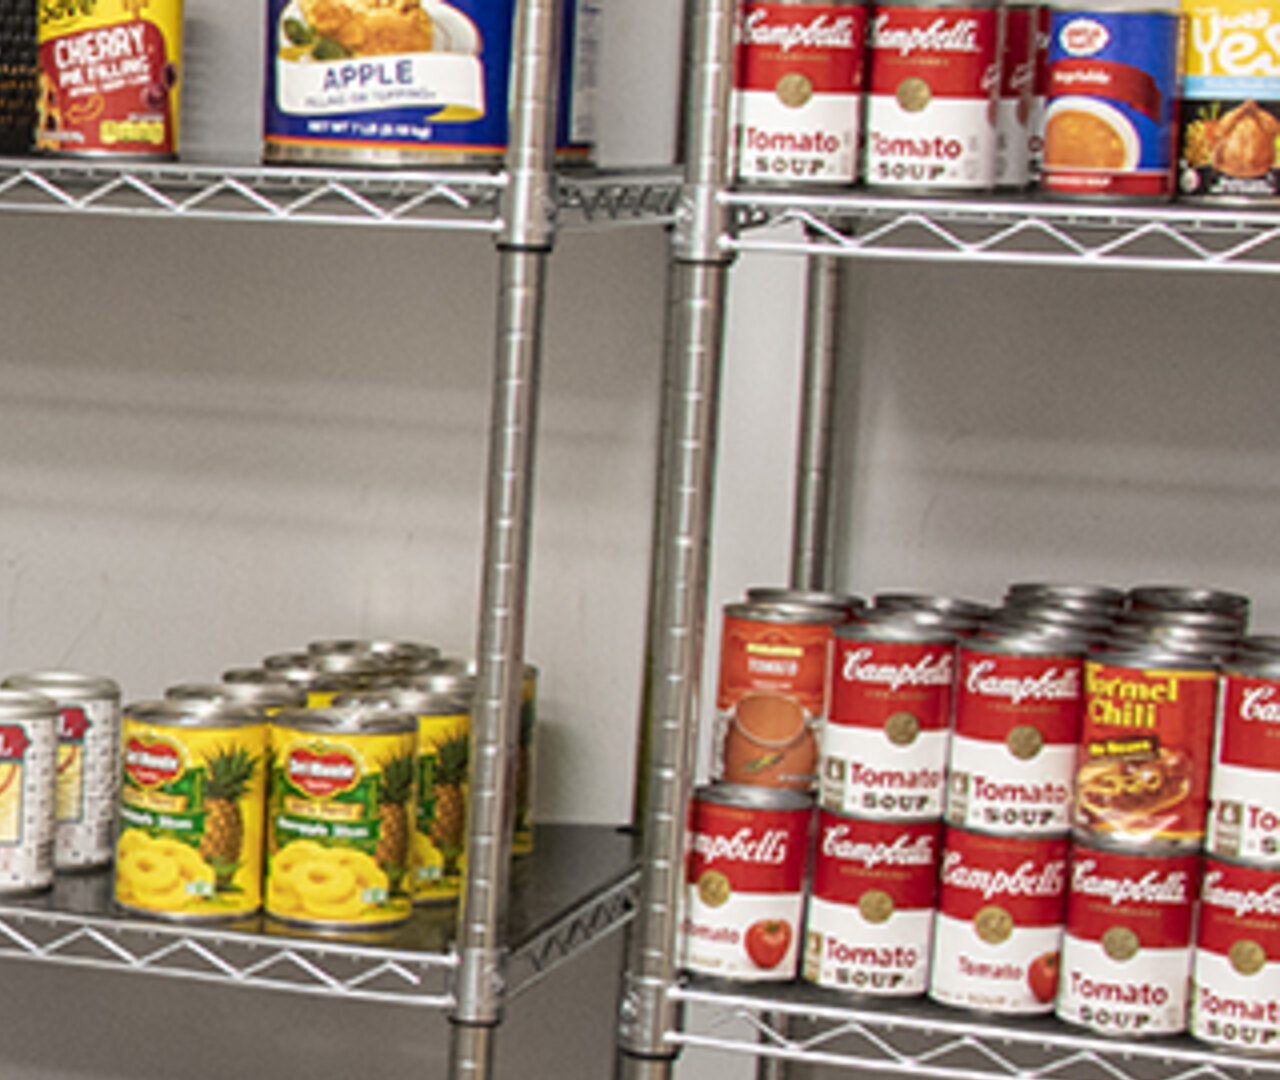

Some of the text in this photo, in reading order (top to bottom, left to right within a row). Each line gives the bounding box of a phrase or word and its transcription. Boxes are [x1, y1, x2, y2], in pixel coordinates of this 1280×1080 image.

[54, 25, 146, 70] CHERRY
[323, 60, 413, 91] APPLE
[747, 128, 839, 153] Tomato
[871, 131, 962, 159] Tomato
[754, 156, 825, 177] SOUP
[879, 163, 945, 180] SOUP
[1089, 700, 1156, 728] Chili
[851, 763, 940, 790] Tomato
[973, 775, 1068, 804] Tomato
[863, 793, 930, 811] SOUP
[984, 808, 1055, 826] SOUP
[826, 941, 918, 971] Tomato
[958, 956, 1023, 982] Tomato
[837, 969, 905, 989] SOUP
[1071, 972, 1169, 1007] Tomato
[1080, 1006, 1149, 1031] SOUP
